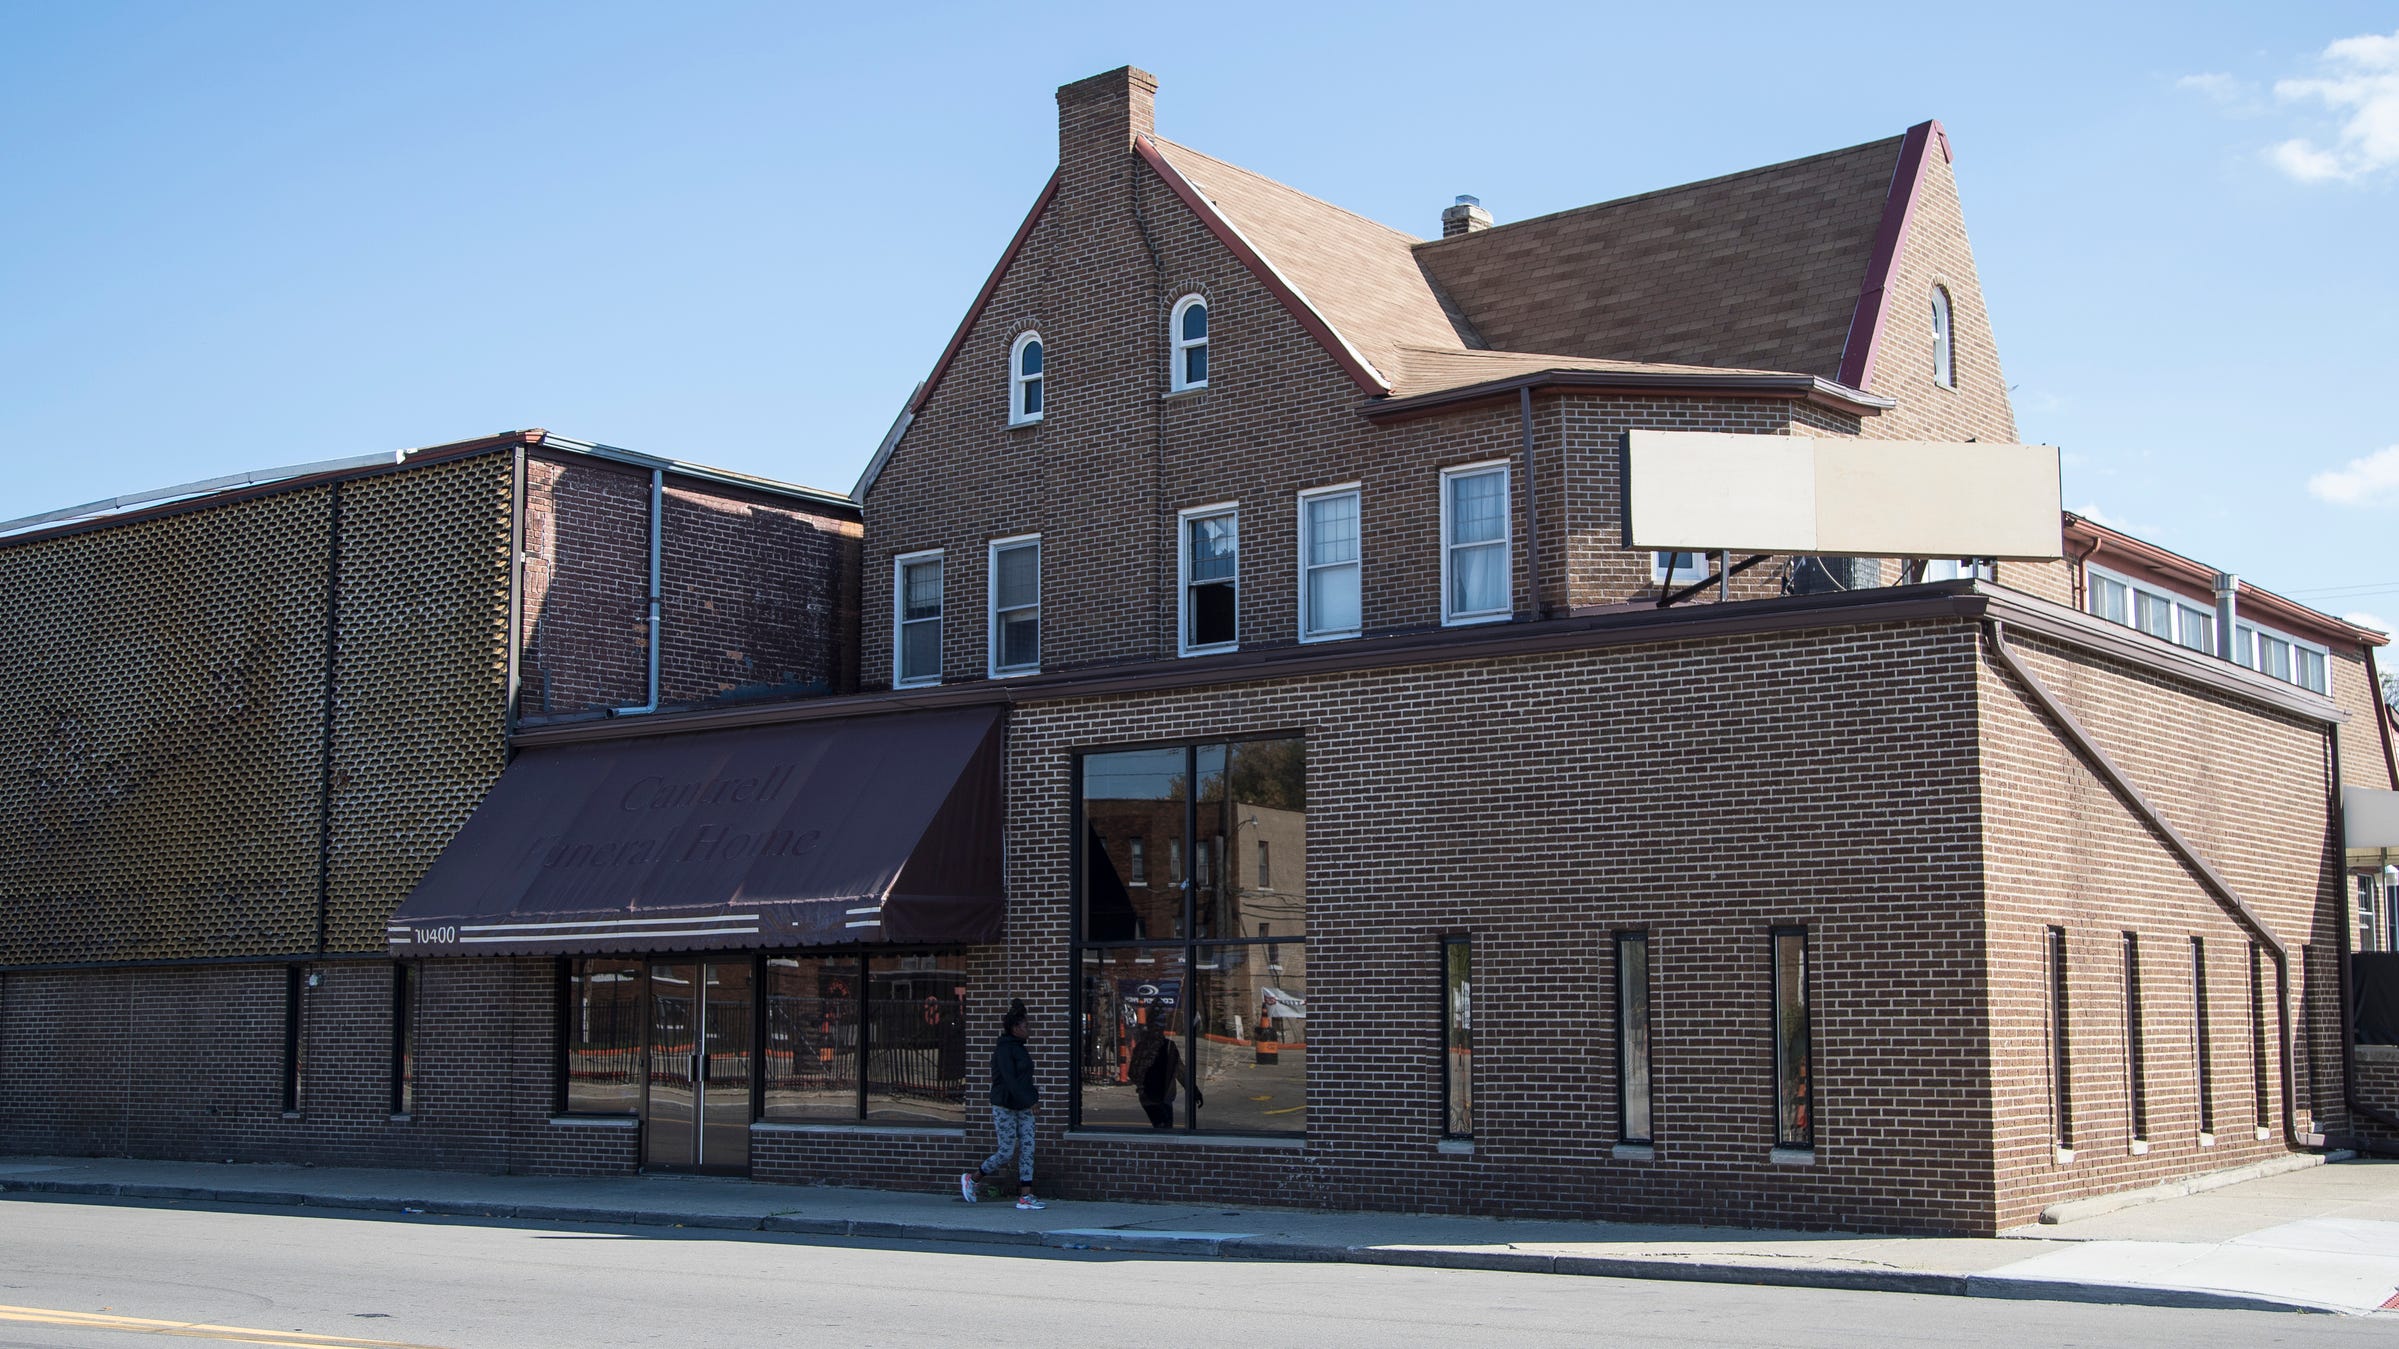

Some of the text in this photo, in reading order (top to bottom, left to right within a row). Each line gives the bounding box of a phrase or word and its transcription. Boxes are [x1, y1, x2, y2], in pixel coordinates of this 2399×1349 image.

[620, 763, 798, 812] Cantrell
[675, 824, 821, 863] Home
[414, 926, 455, 943] 10400
